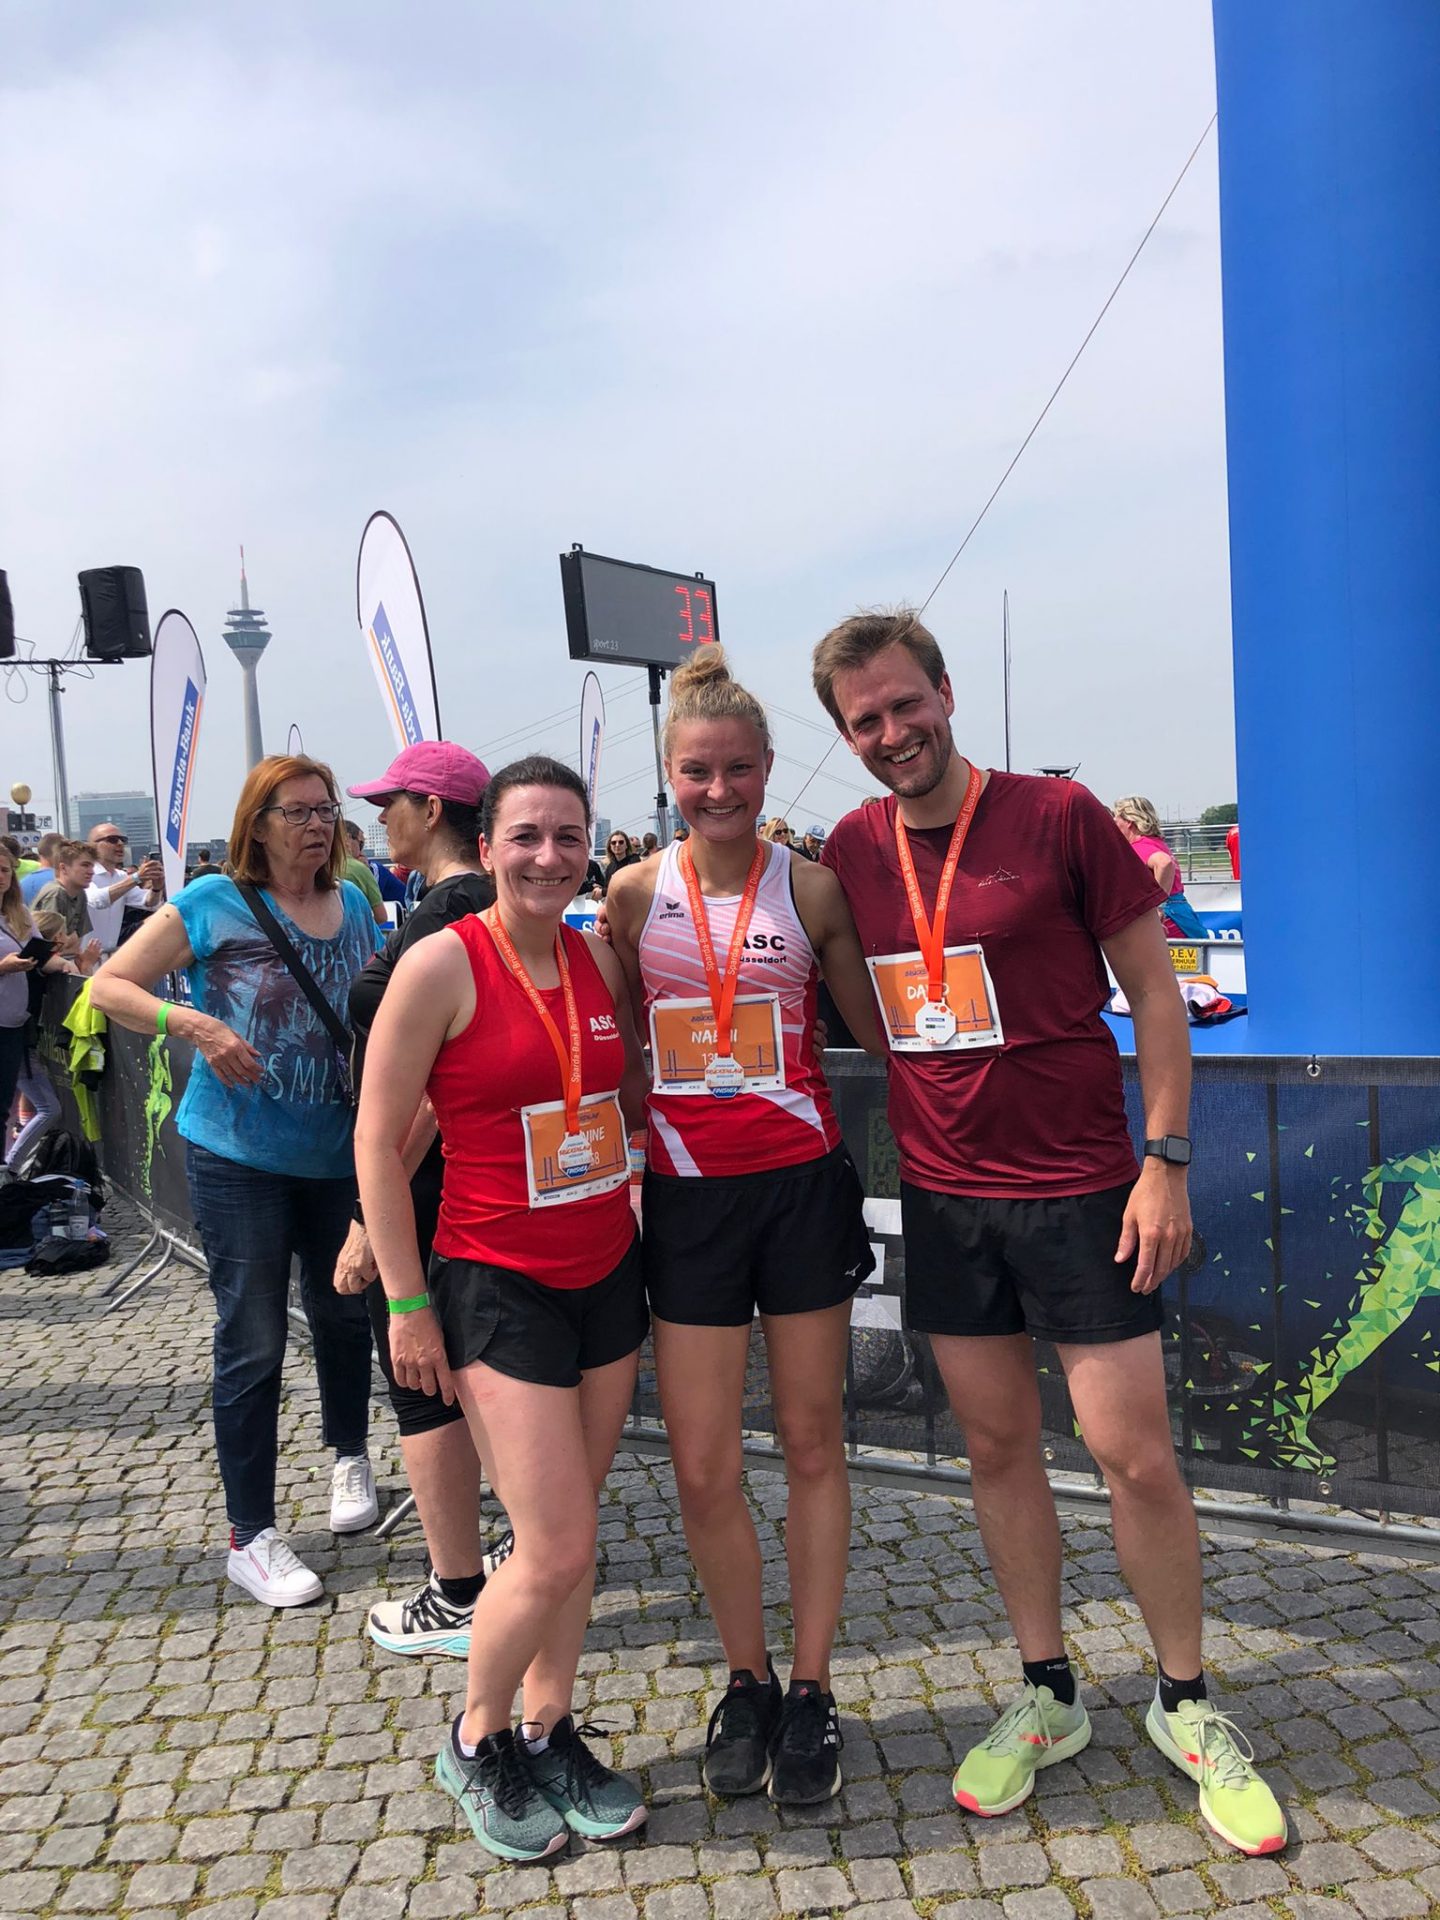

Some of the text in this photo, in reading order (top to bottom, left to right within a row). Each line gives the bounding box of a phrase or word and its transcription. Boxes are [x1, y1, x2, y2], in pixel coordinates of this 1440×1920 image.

[675, 585, 713, 645] 33
[170, 701, 195, 830] Sparda-Bank
[938, 862, 954, 911] Sparda-Bank
[659, 911, 685, 920] erima
[697, 925, 715, 971] Sparda-Bank
[727, 929, 744, 975] Sparda-Bank
[740, 955, 787, 963] üsseldorf
[517, 970, 546, 1014] Sparda-Bank
[589, 1014, 616, 1032] ASC
[267, 1053, 340, 1104] SMIL
[570, 1033, 580, 1082] Sparda-Bank
